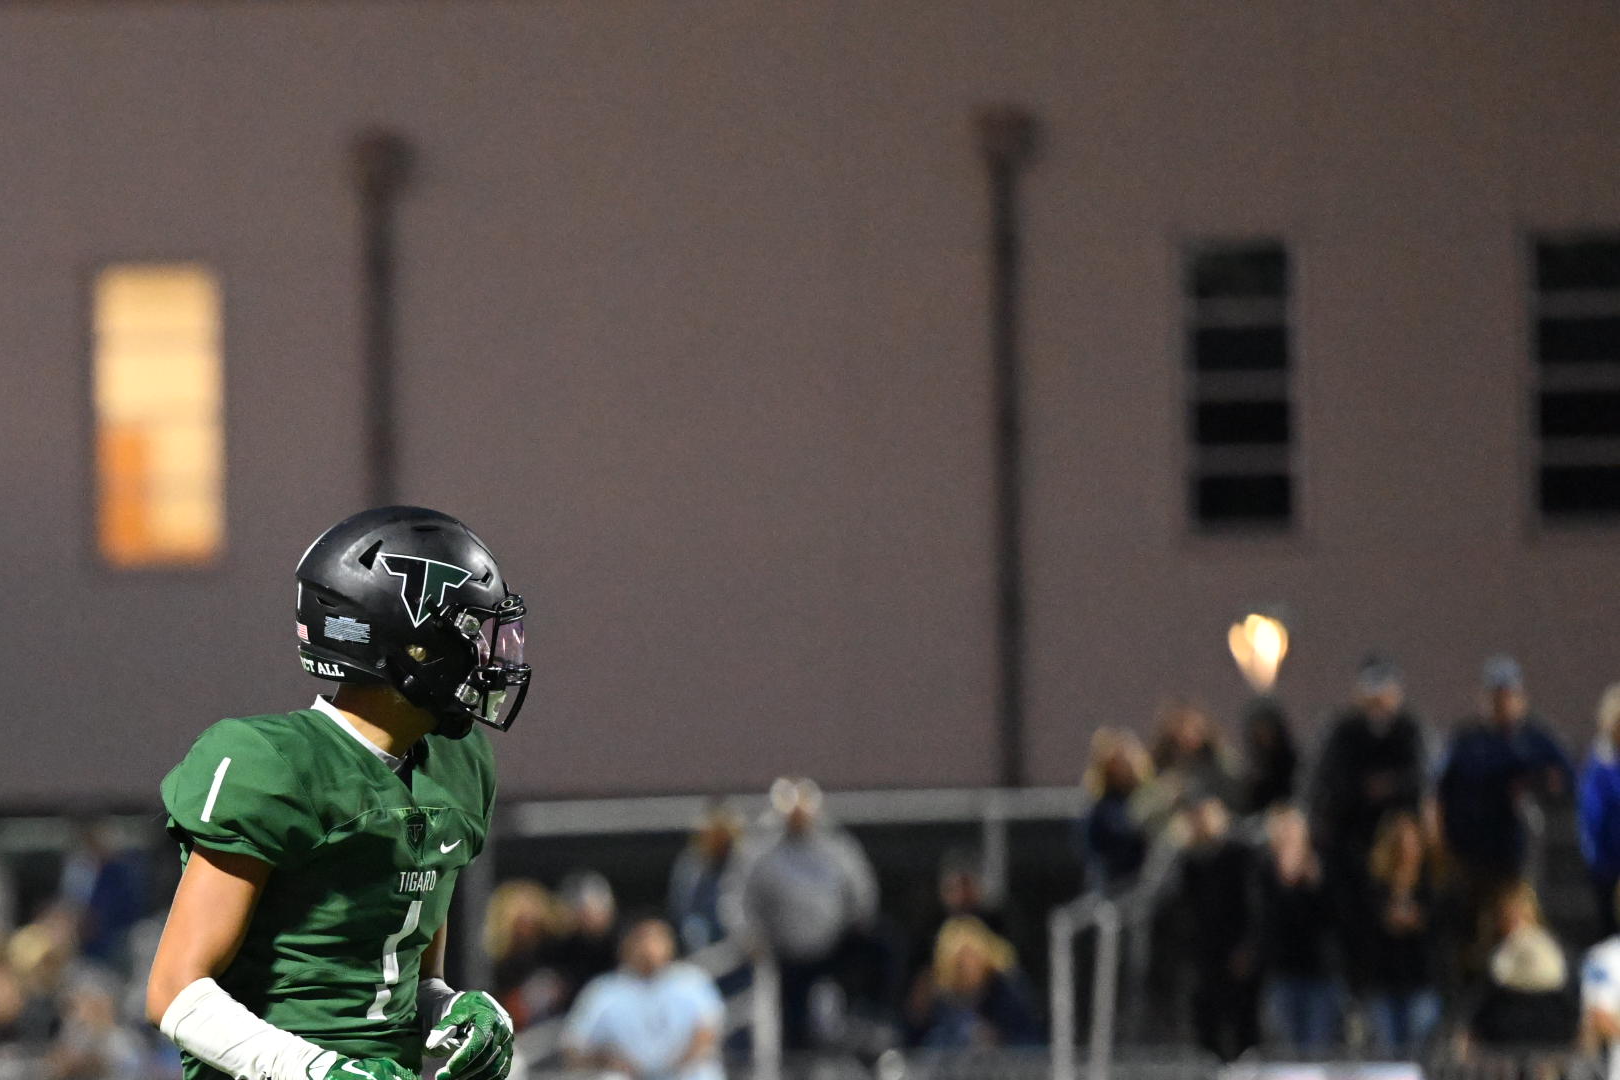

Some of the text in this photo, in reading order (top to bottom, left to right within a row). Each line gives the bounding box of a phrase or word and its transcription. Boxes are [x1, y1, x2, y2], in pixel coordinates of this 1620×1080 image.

[317, 661, 345, 677] ALL
[200, 756, 232, 823] 1
[399, 870, 437, 893] TIGARD
[366, 900, 423, 1021] 1
